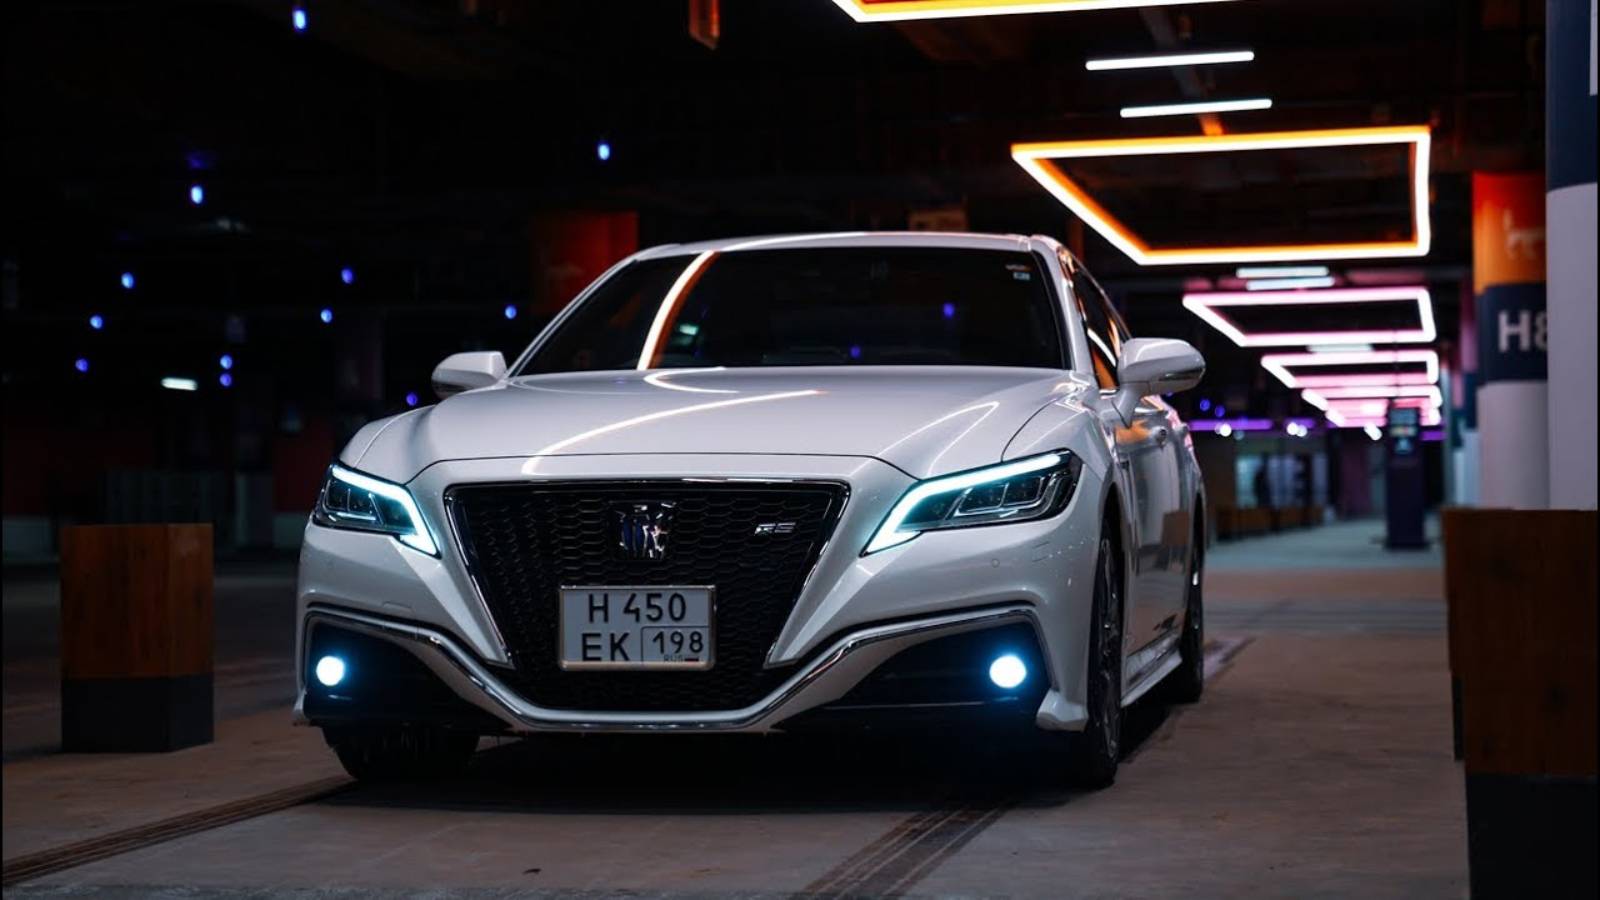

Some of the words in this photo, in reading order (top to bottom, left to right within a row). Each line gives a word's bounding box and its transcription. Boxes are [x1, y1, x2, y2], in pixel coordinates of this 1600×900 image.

[588, 593, 609, 623] H
[623, 592, 686, 622] 450
[582, 632, 631, 661] EK
[652, 631, 703, 653] 198
